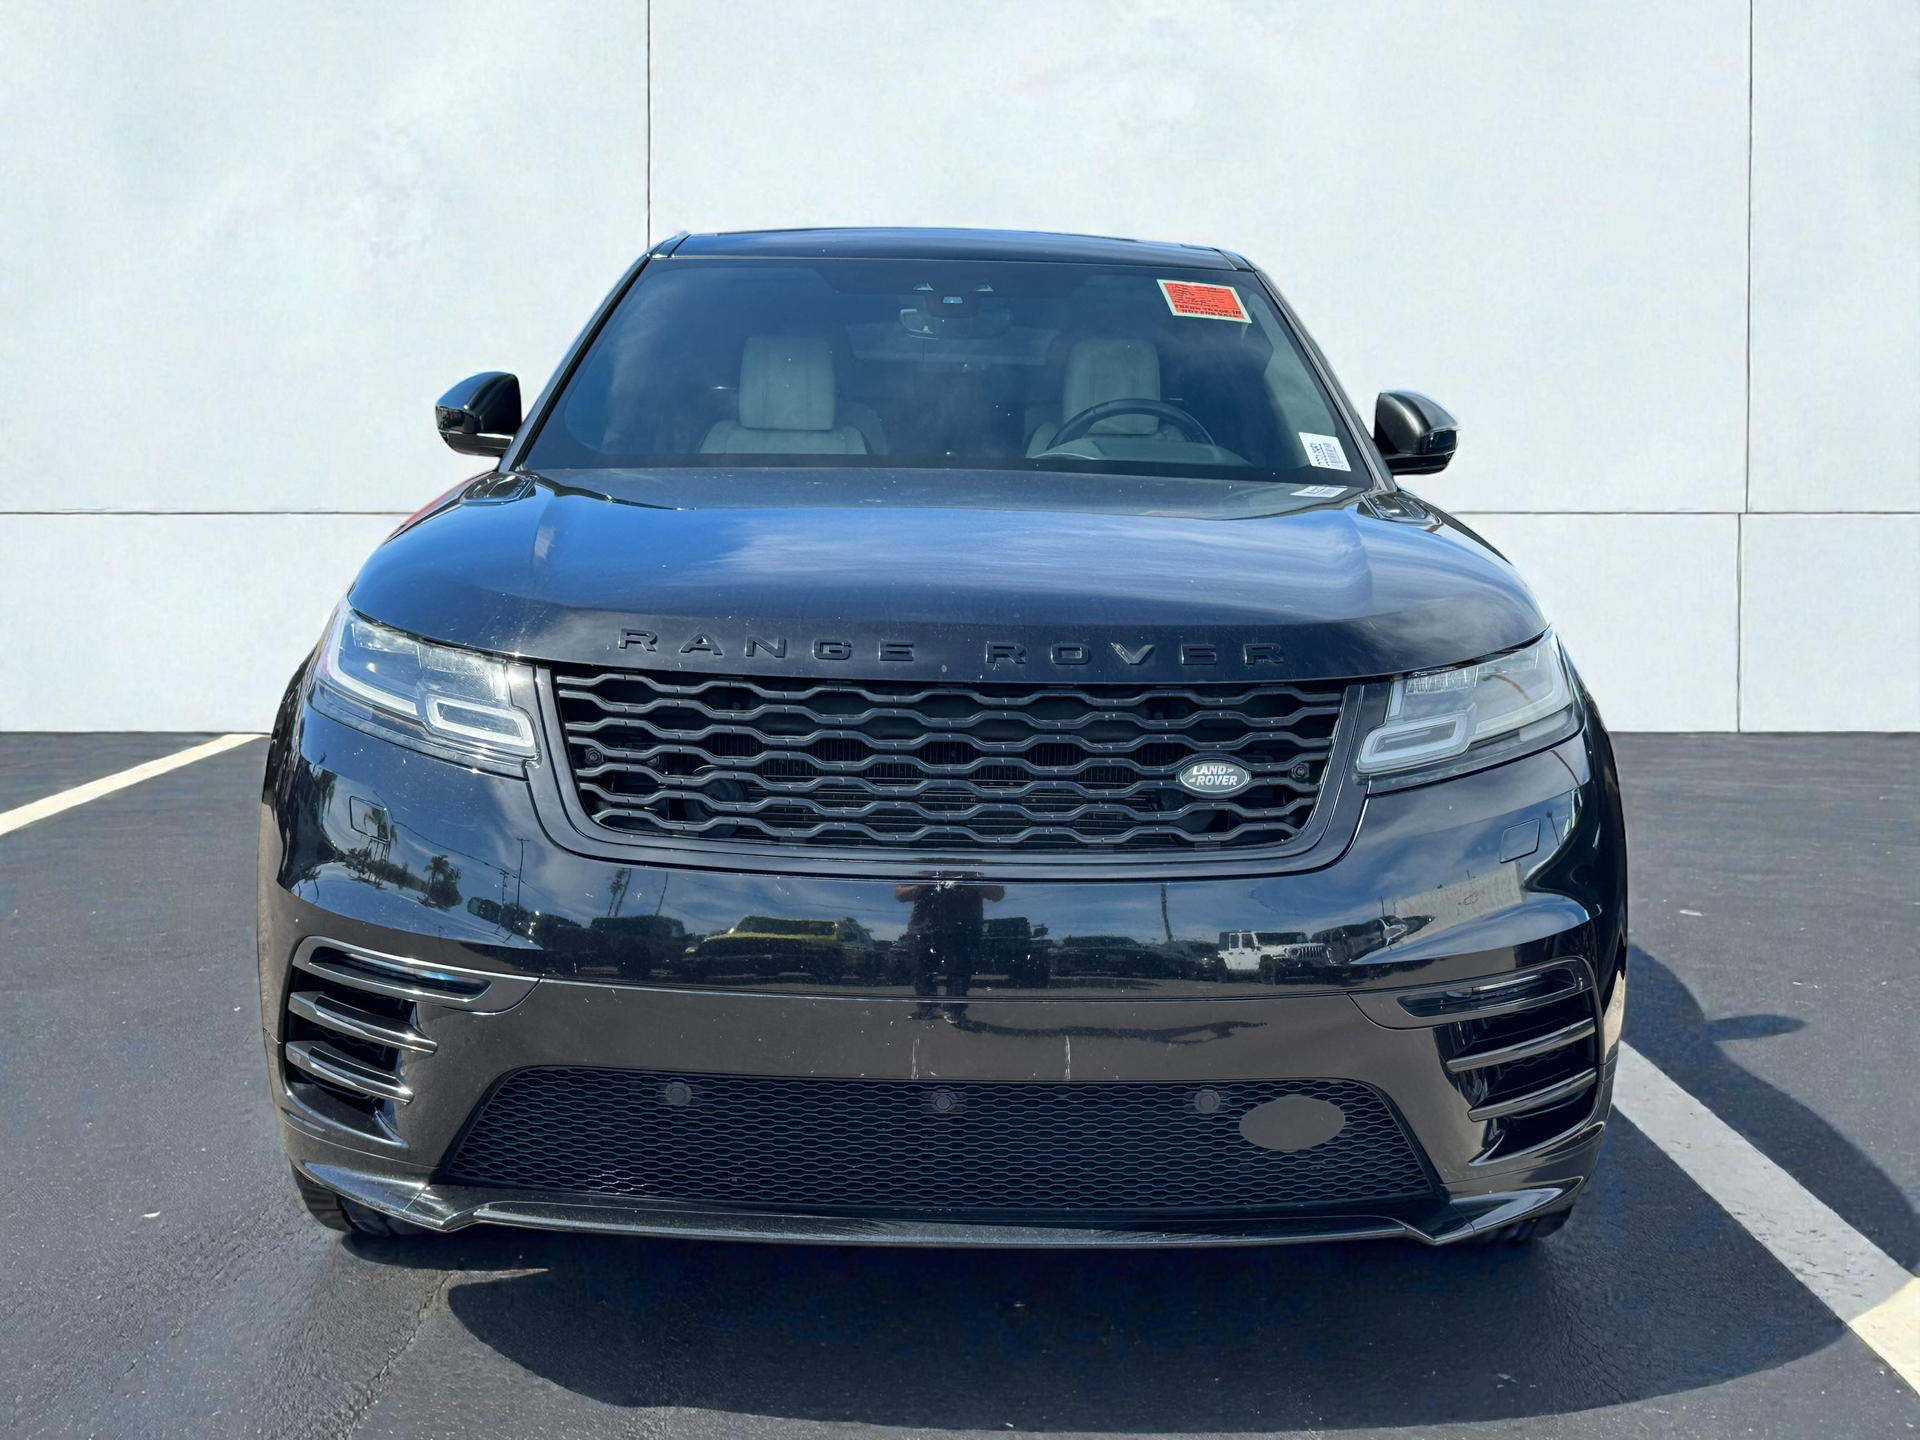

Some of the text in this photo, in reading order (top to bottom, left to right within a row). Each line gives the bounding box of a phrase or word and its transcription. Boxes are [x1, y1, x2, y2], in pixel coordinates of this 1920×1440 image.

[618, 628, 1285, 666] RANGE ROVER
[1192, 765, 1227, 775] LAND
[1196, 775, 1238, 786] ROVER
